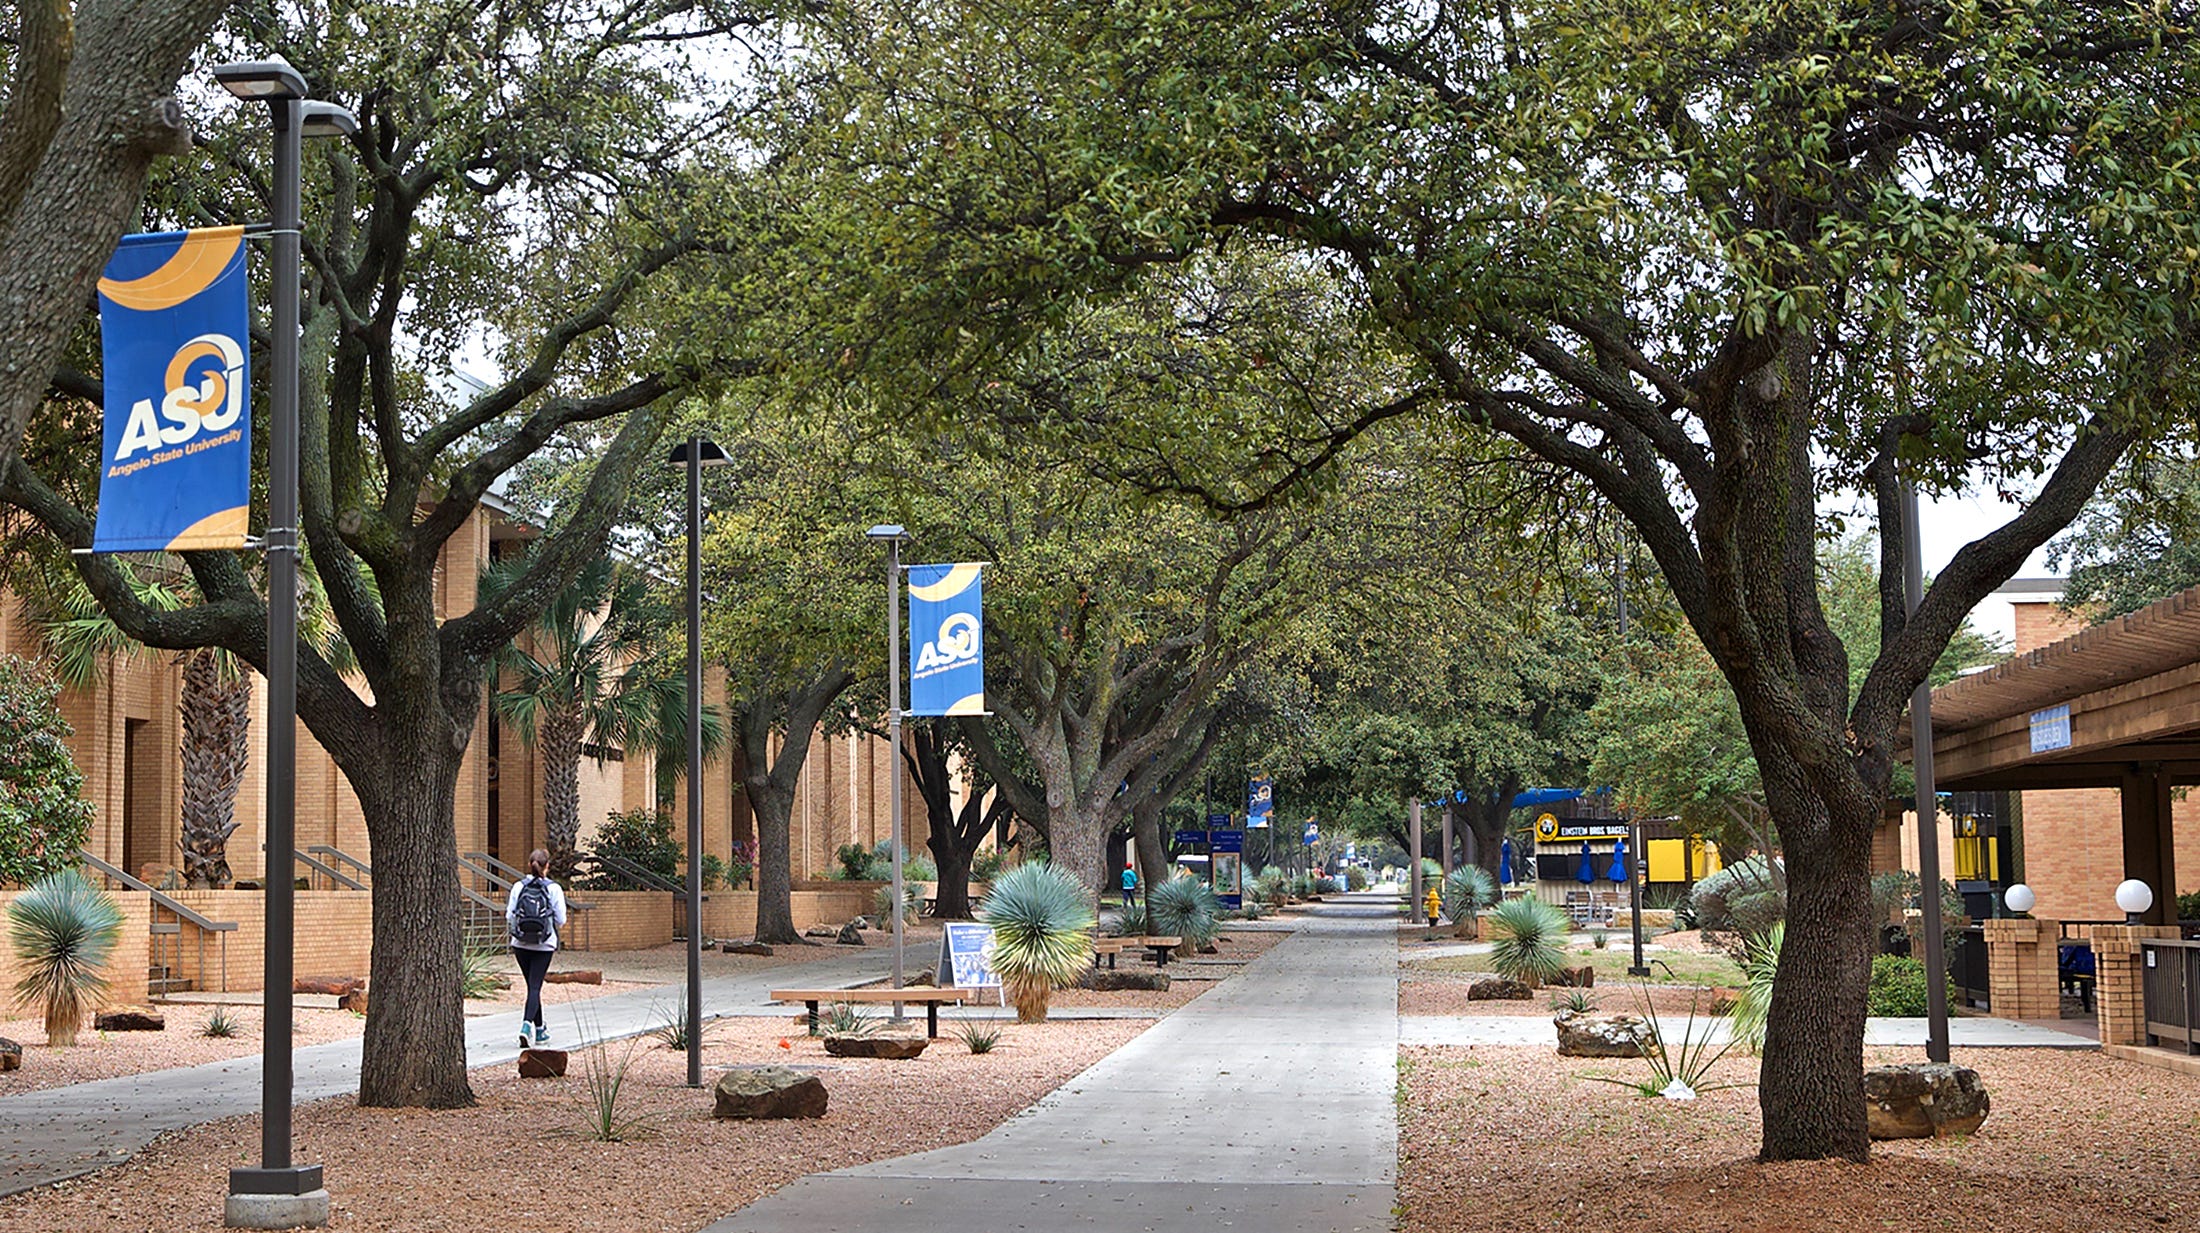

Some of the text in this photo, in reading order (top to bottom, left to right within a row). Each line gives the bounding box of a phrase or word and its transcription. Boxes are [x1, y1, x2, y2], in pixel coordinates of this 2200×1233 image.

[114, 333, 245, 461] ASU
[107, 429, 242, 478] Angelo State University
[915, 612, 980, 671] ASU
